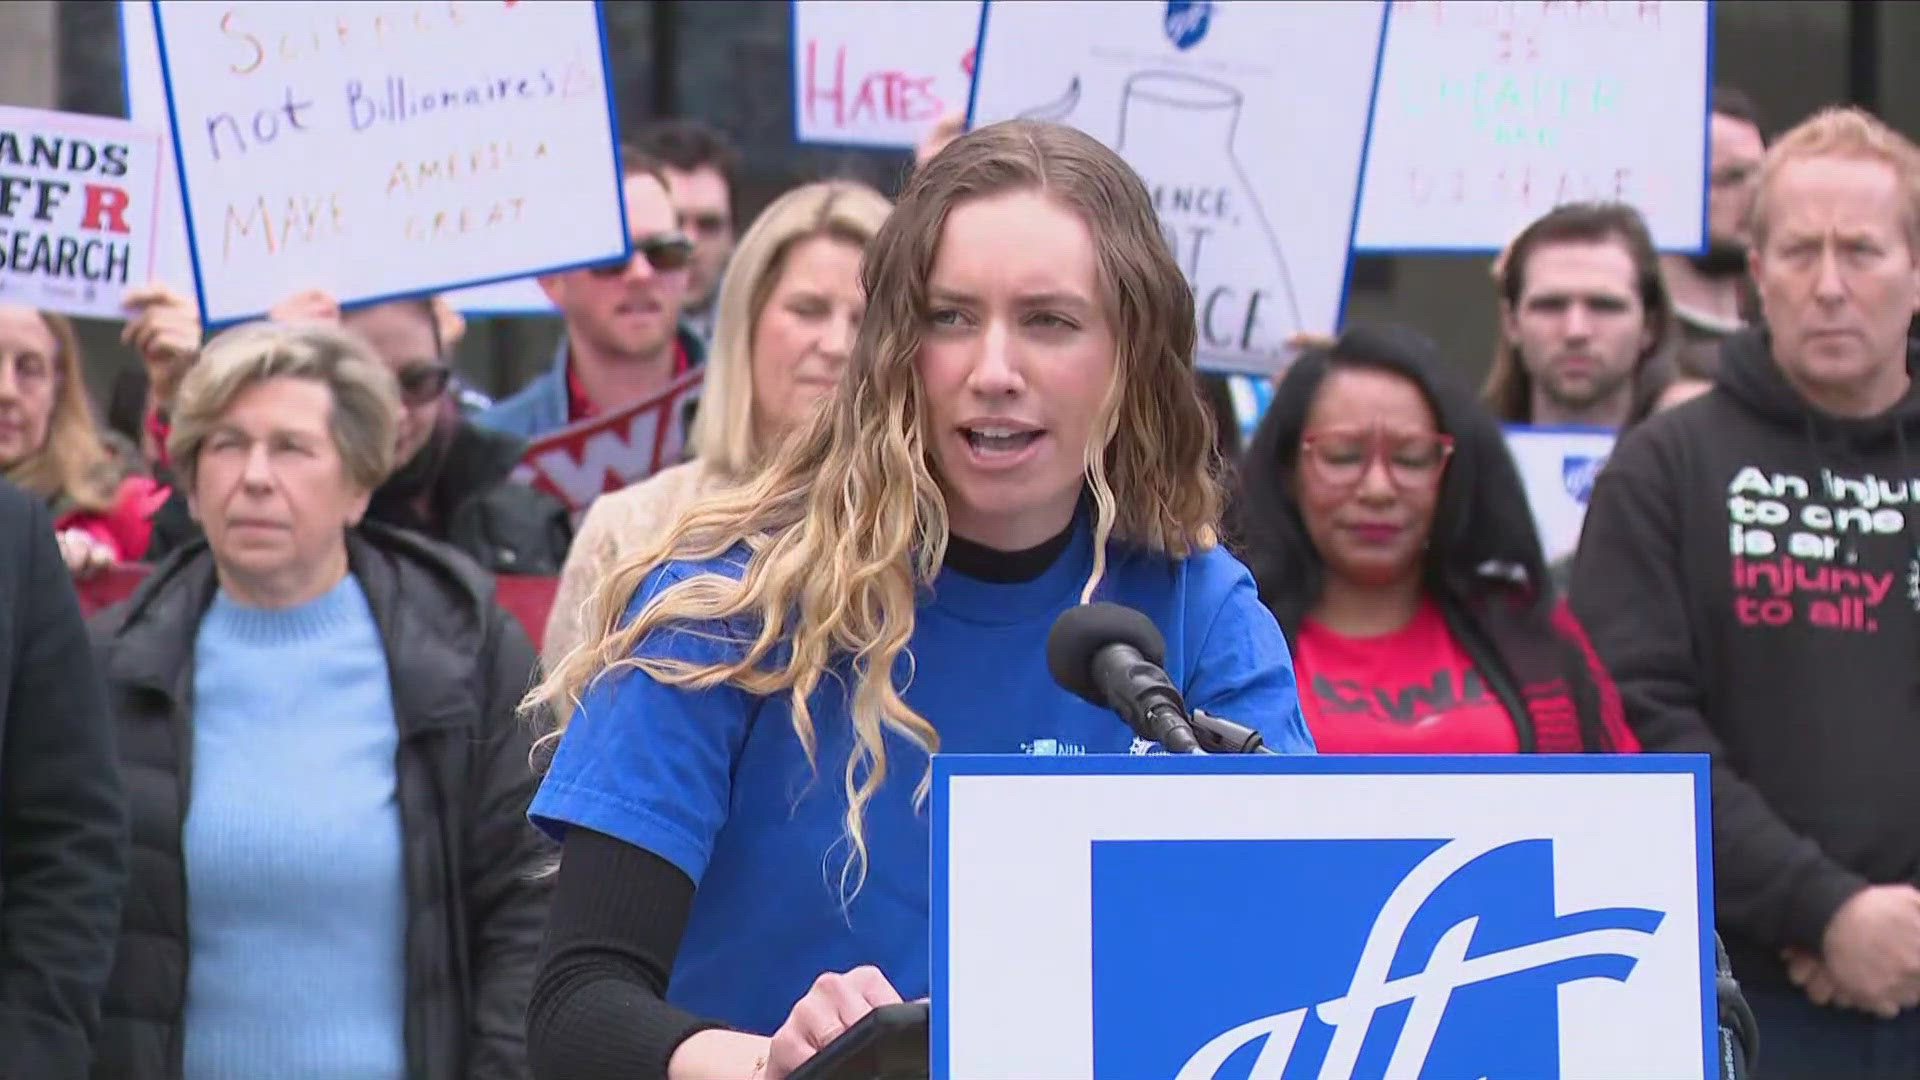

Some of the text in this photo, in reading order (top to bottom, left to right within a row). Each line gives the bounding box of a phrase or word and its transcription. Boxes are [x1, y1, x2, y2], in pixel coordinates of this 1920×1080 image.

[806, 38, 944, 129] HATES
[206, 70, 555, 160] not Billionaires
[81, 182, 131, 234] R
[1729, 466, 1810, 499] An
[1728, 496, 1791, 526] to
[1735, 597, 1793, 626] to
